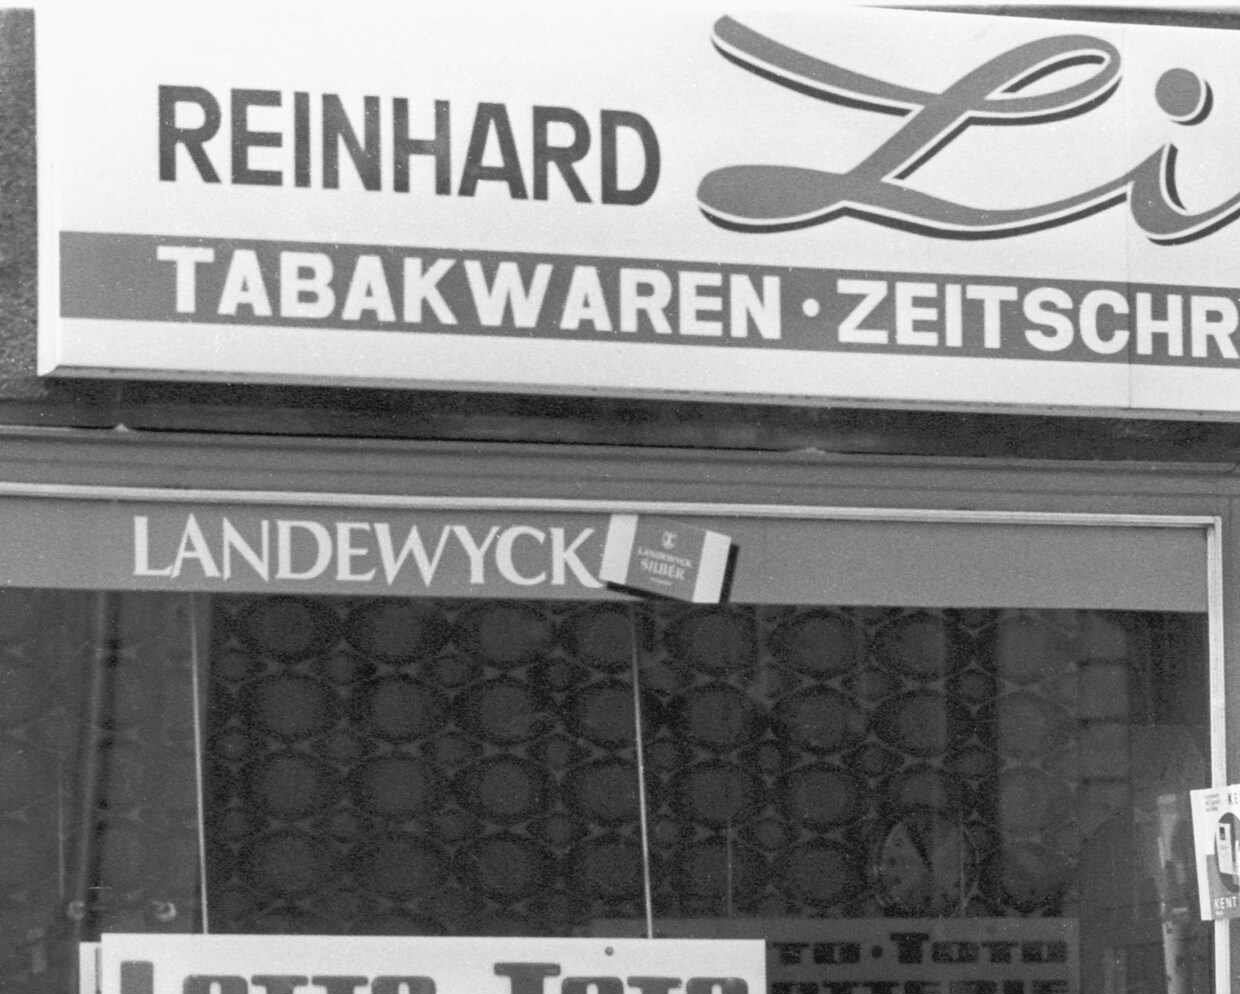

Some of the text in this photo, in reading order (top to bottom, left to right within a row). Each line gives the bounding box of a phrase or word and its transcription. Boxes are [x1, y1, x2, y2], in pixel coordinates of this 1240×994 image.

[157, 84, 661, 206] REINHARD
[156, 245, 782, 341] TABAKWAREN
[132, 513, 604, 589] LANDEWYCK
[1213, 896, 1238, 910] KENT
